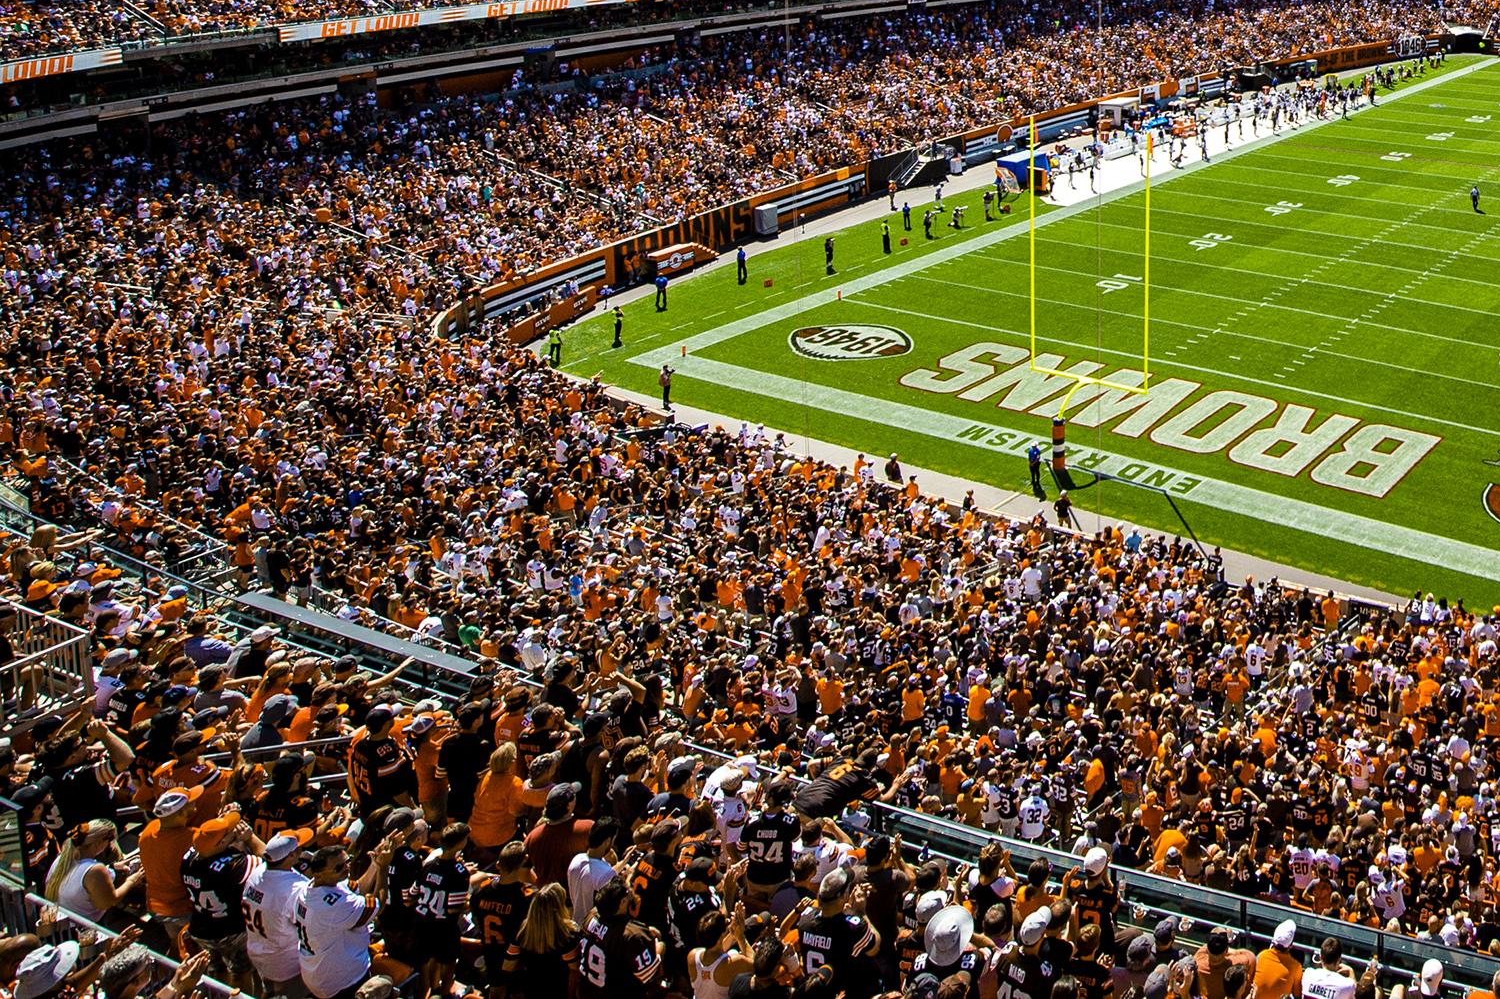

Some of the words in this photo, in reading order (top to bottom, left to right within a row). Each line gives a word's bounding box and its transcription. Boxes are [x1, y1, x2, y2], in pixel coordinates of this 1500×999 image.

[487, 1, 521, 18] GET
[321, 21, 364, 38] GET
[366, 14, 420, 33] LOUD!
[1400, 38, 1422, 55] 1946
[1096, 273, 1143, 294] 10
[809, 328, 896, 355] 1946
[899, 342, 1443, 498] BROWNS
[1118, 461, 1202, 495] END
[1249, 655, 1256, 666] 6
[1364, 704, 1377, 716] 00
[1027, 808, 1041, 823] 32
[1229, 817, 1244, 830] 24
[756, 829, 778, 839] CHUBB
[750, 841, 784, 863] 24
[426, 873, 443, 885] CHUBB
[415, 884, 446, 919] 24
[685, 894, 704, 911] 24
[484, 914, 504, 944] 6
[803, 931, 832, 950] MAYFIELD
[580, 938, 607, 987] 19
[635, 948, 652, 971] 19
[806, 951, 825, 976] 6
[1008, 964, 1025, 984] WARD
[1308, 983, 1337, 999] GARRETT
